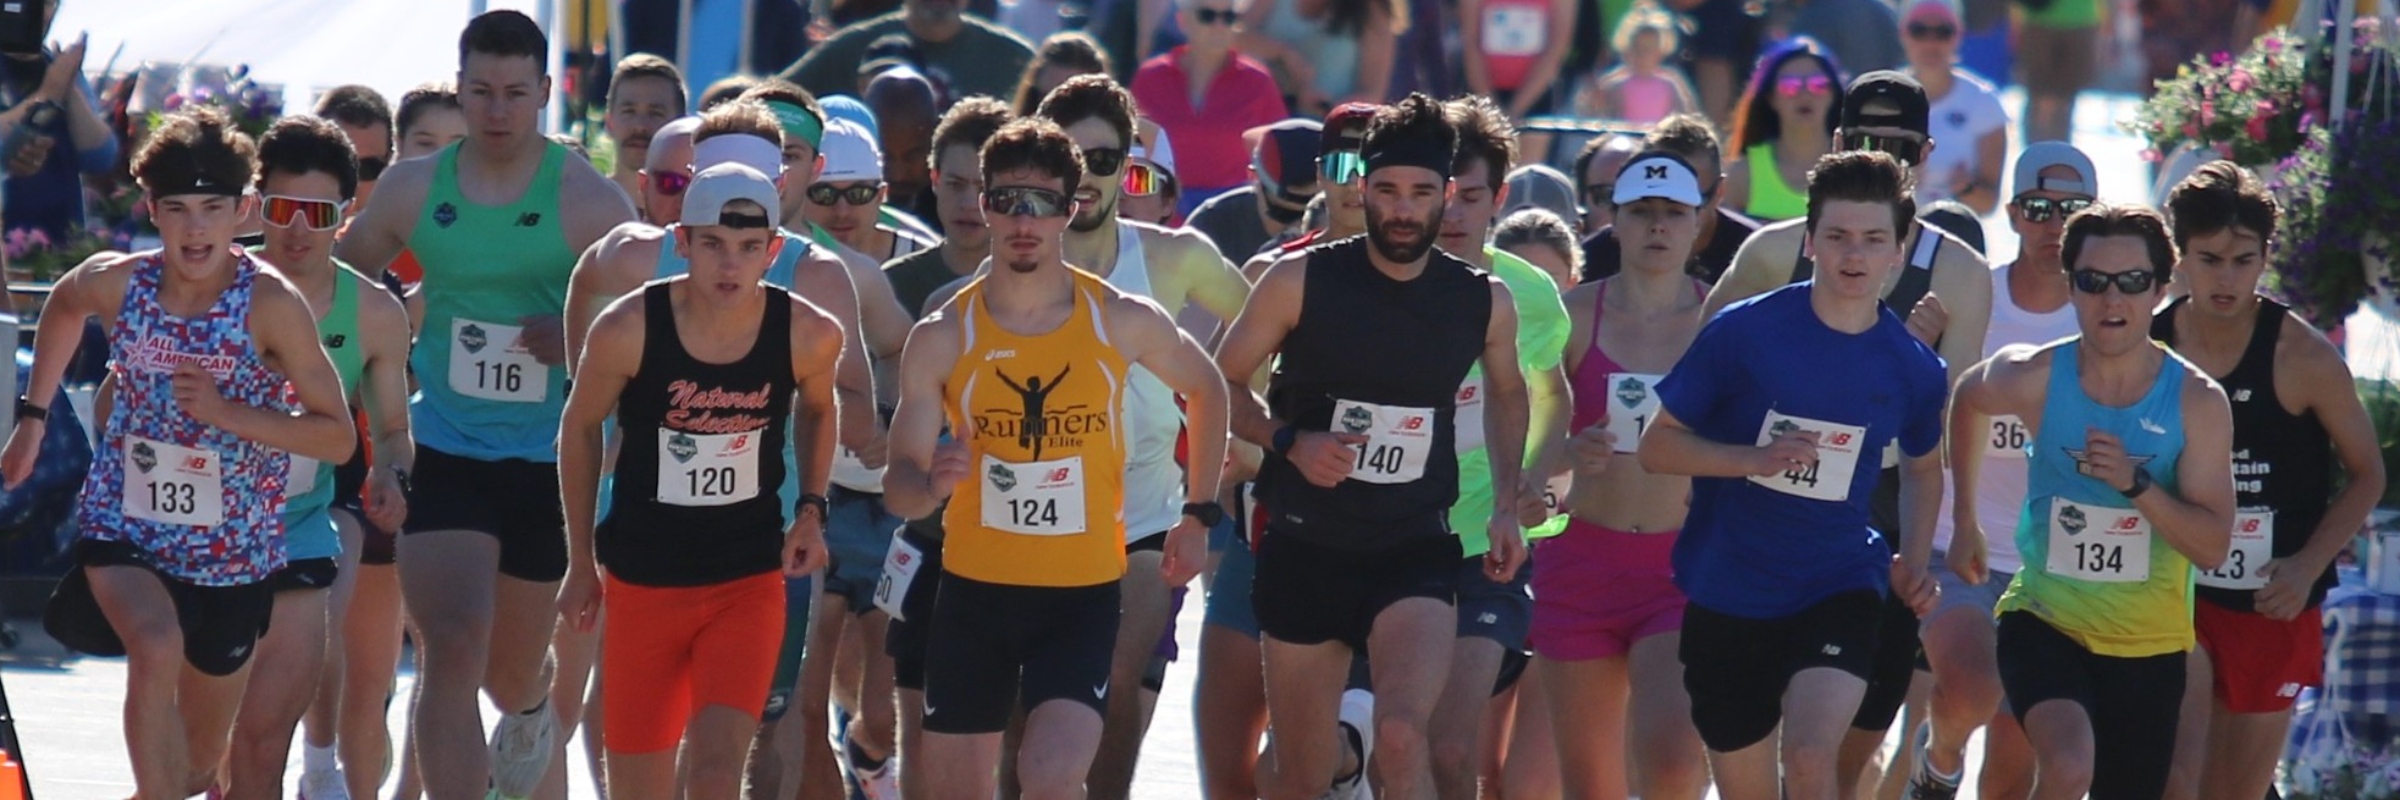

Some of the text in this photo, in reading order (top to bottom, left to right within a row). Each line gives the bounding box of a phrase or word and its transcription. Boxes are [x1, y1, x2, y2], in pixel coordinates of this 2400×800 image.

[1644, 165, 1668, 180] M
[148, 337, 174, 352] ALL
[474, 360, 522, 393] 116
[667, 379, 772, 410] Natural
[1048, 437, 1083, 449] Elite
[1992, 421, 2025, 450] 36
[1355, 441, 1405, 475] 140
[685, 466, 736, 497] 120
[2235, 479, 2263, 494] ng
[146, 481, 196, 515] 133
[1007, 497, 1059, 527] 124
[2073, 541, 2124, 574] 134
